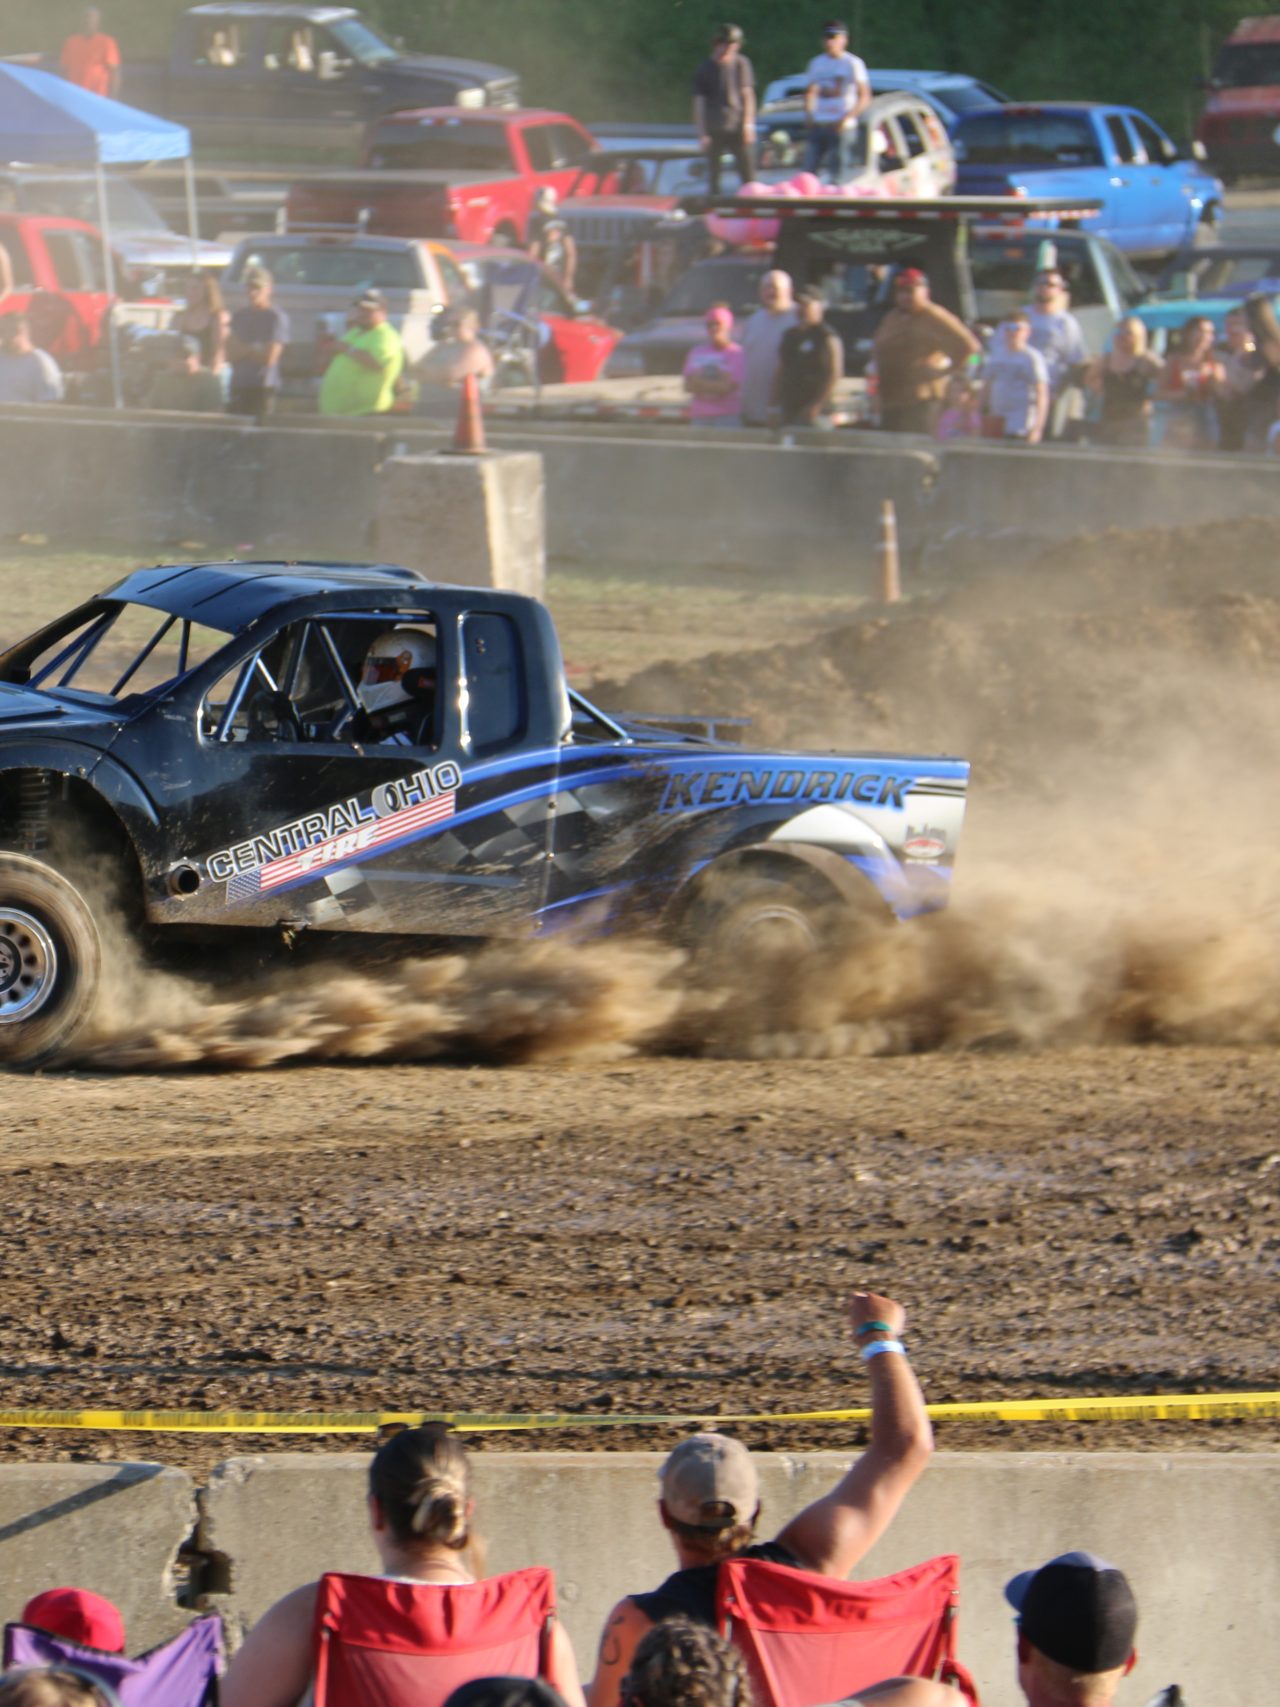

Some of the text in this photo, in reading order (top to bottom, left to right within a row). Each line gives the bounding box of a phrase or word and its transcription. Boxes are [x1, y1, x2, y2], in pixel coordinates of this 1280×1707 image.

[660, 770, 913, 812] KENDRICK
[206, 760, 462, 883] CENTRAL OHIO
[295, 823, 381, 872] TIRE
